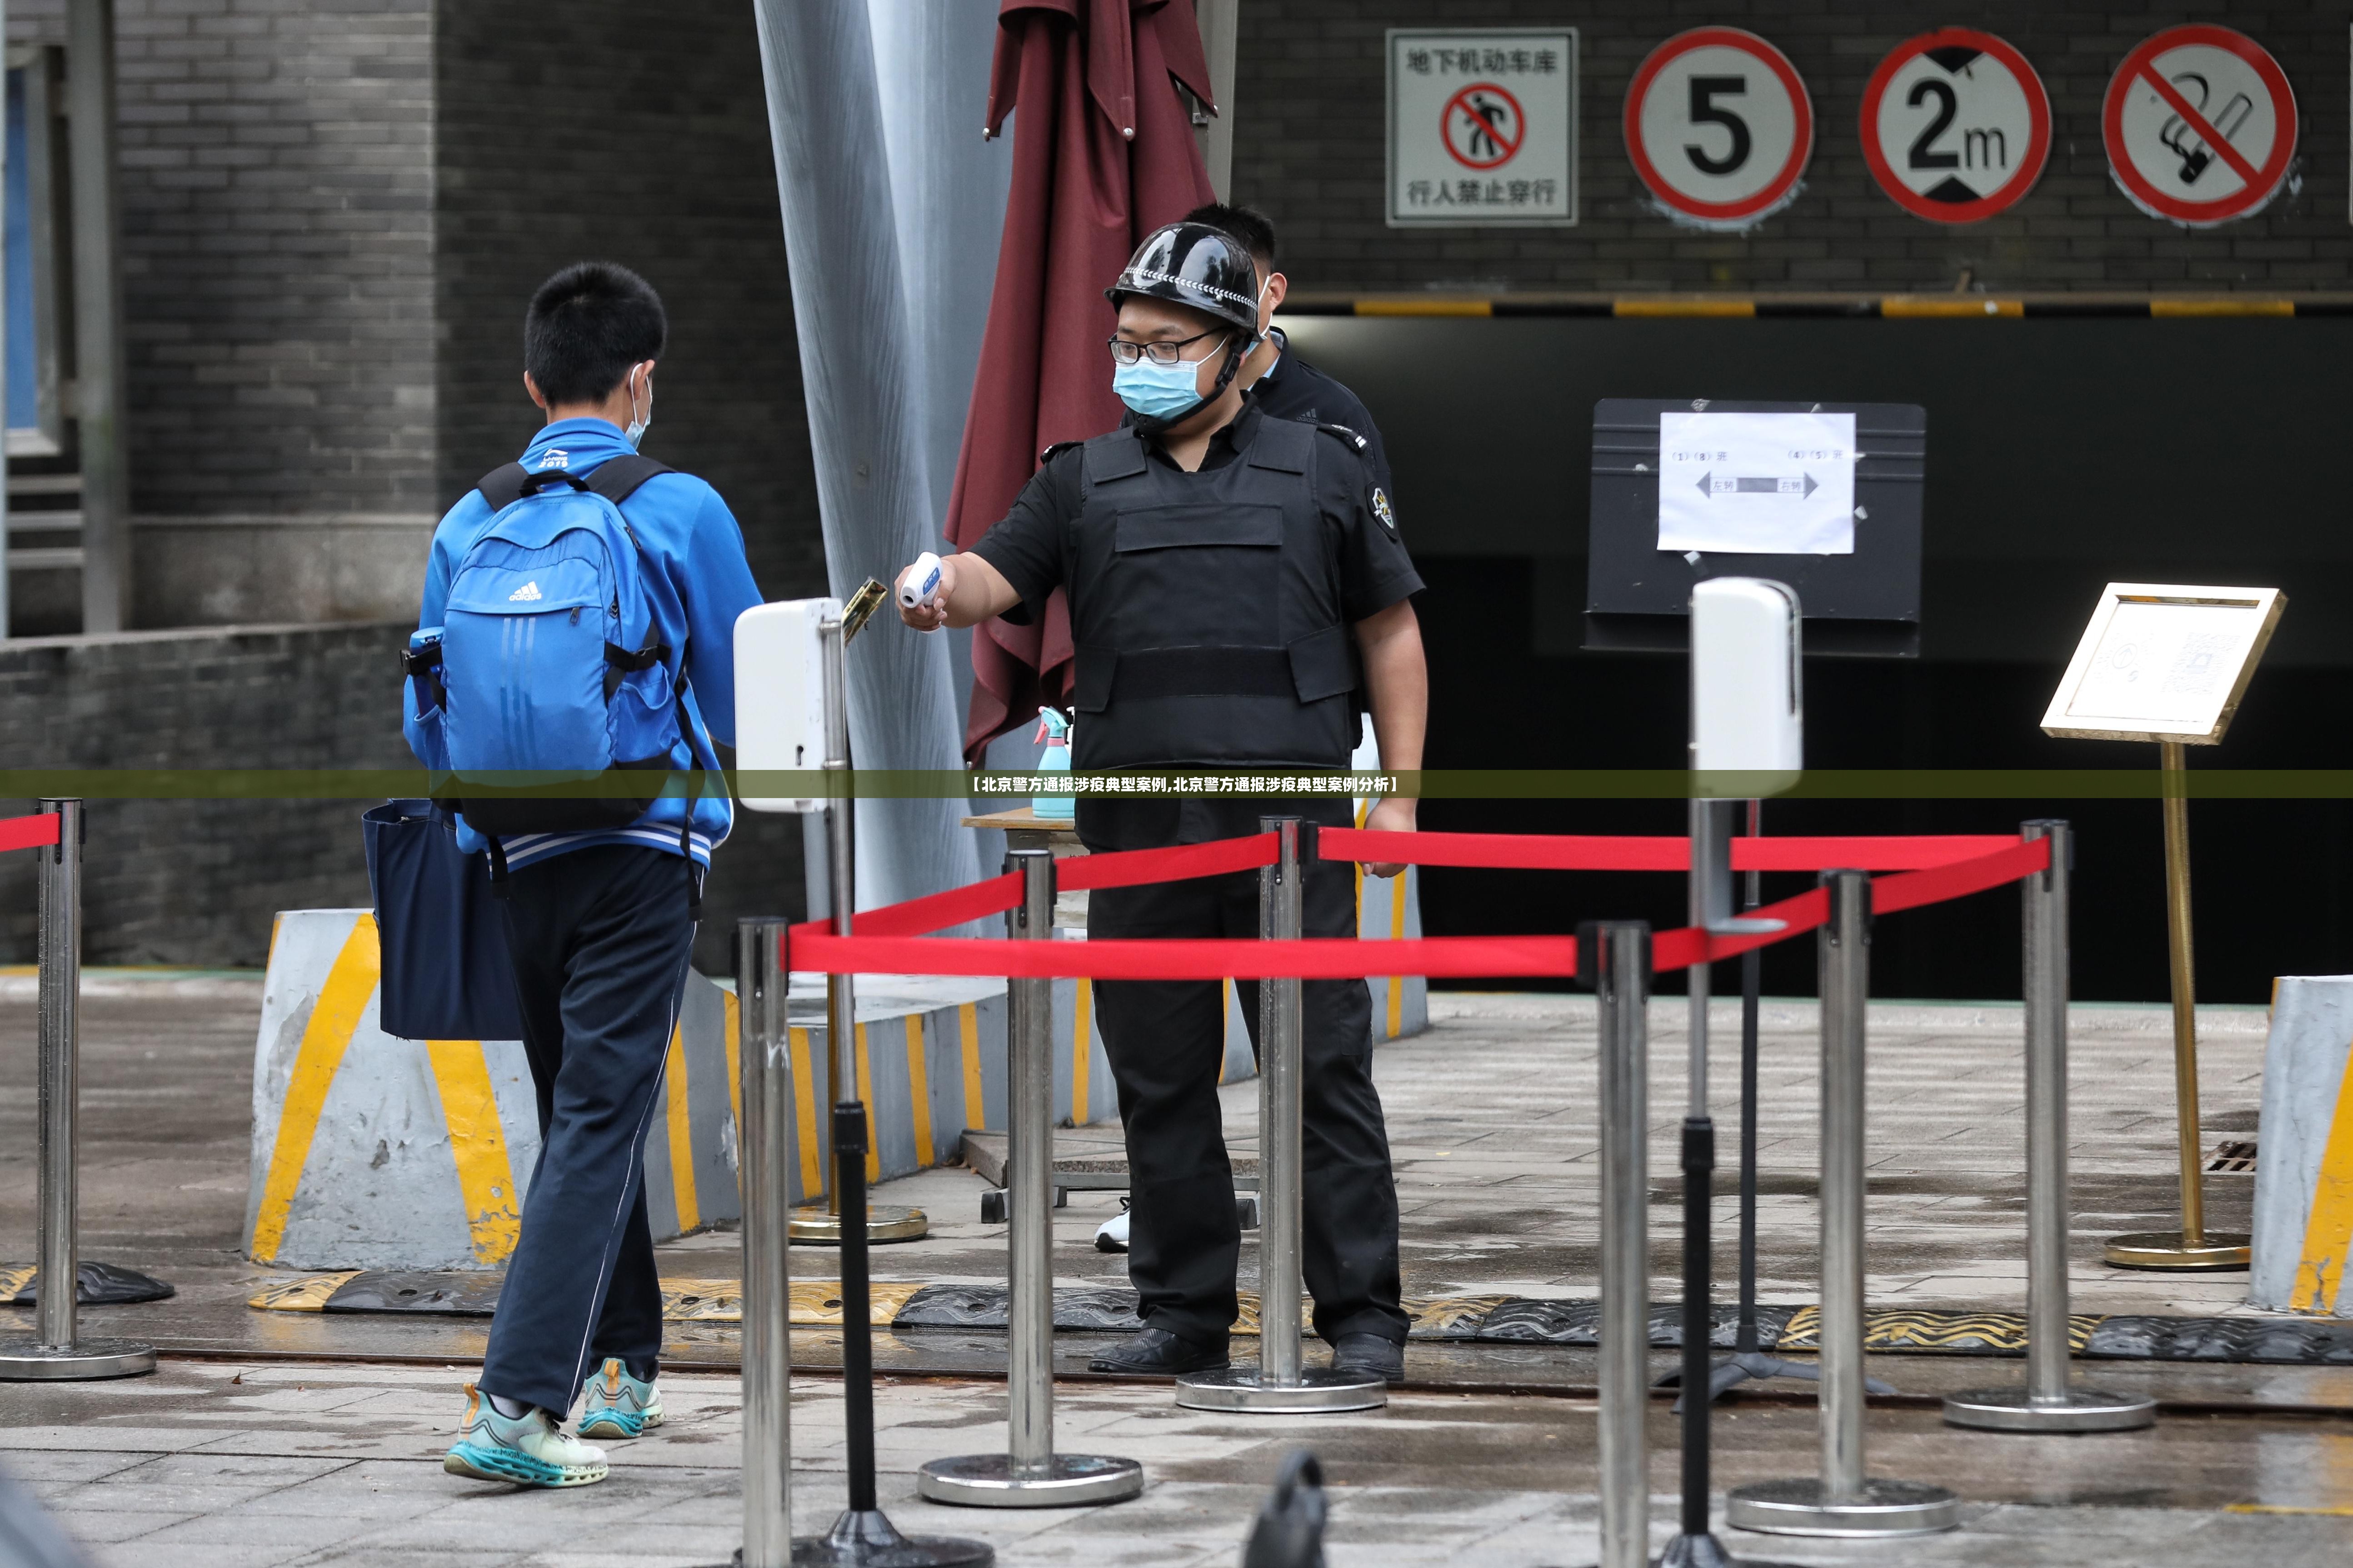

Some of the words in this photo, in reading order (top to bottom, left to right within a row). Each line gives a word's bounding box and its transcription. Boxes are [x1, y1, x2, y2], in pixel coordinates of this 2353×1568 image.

[1407, 48, 1557, 75] 地下机动车库
[1684, 75, 1752, 175] 5
[1408, 179, 1555, 206] 行人禁止穿行
[1712, 480, 1734, 491] 左转
[509, 592, 542, 601] adidas
